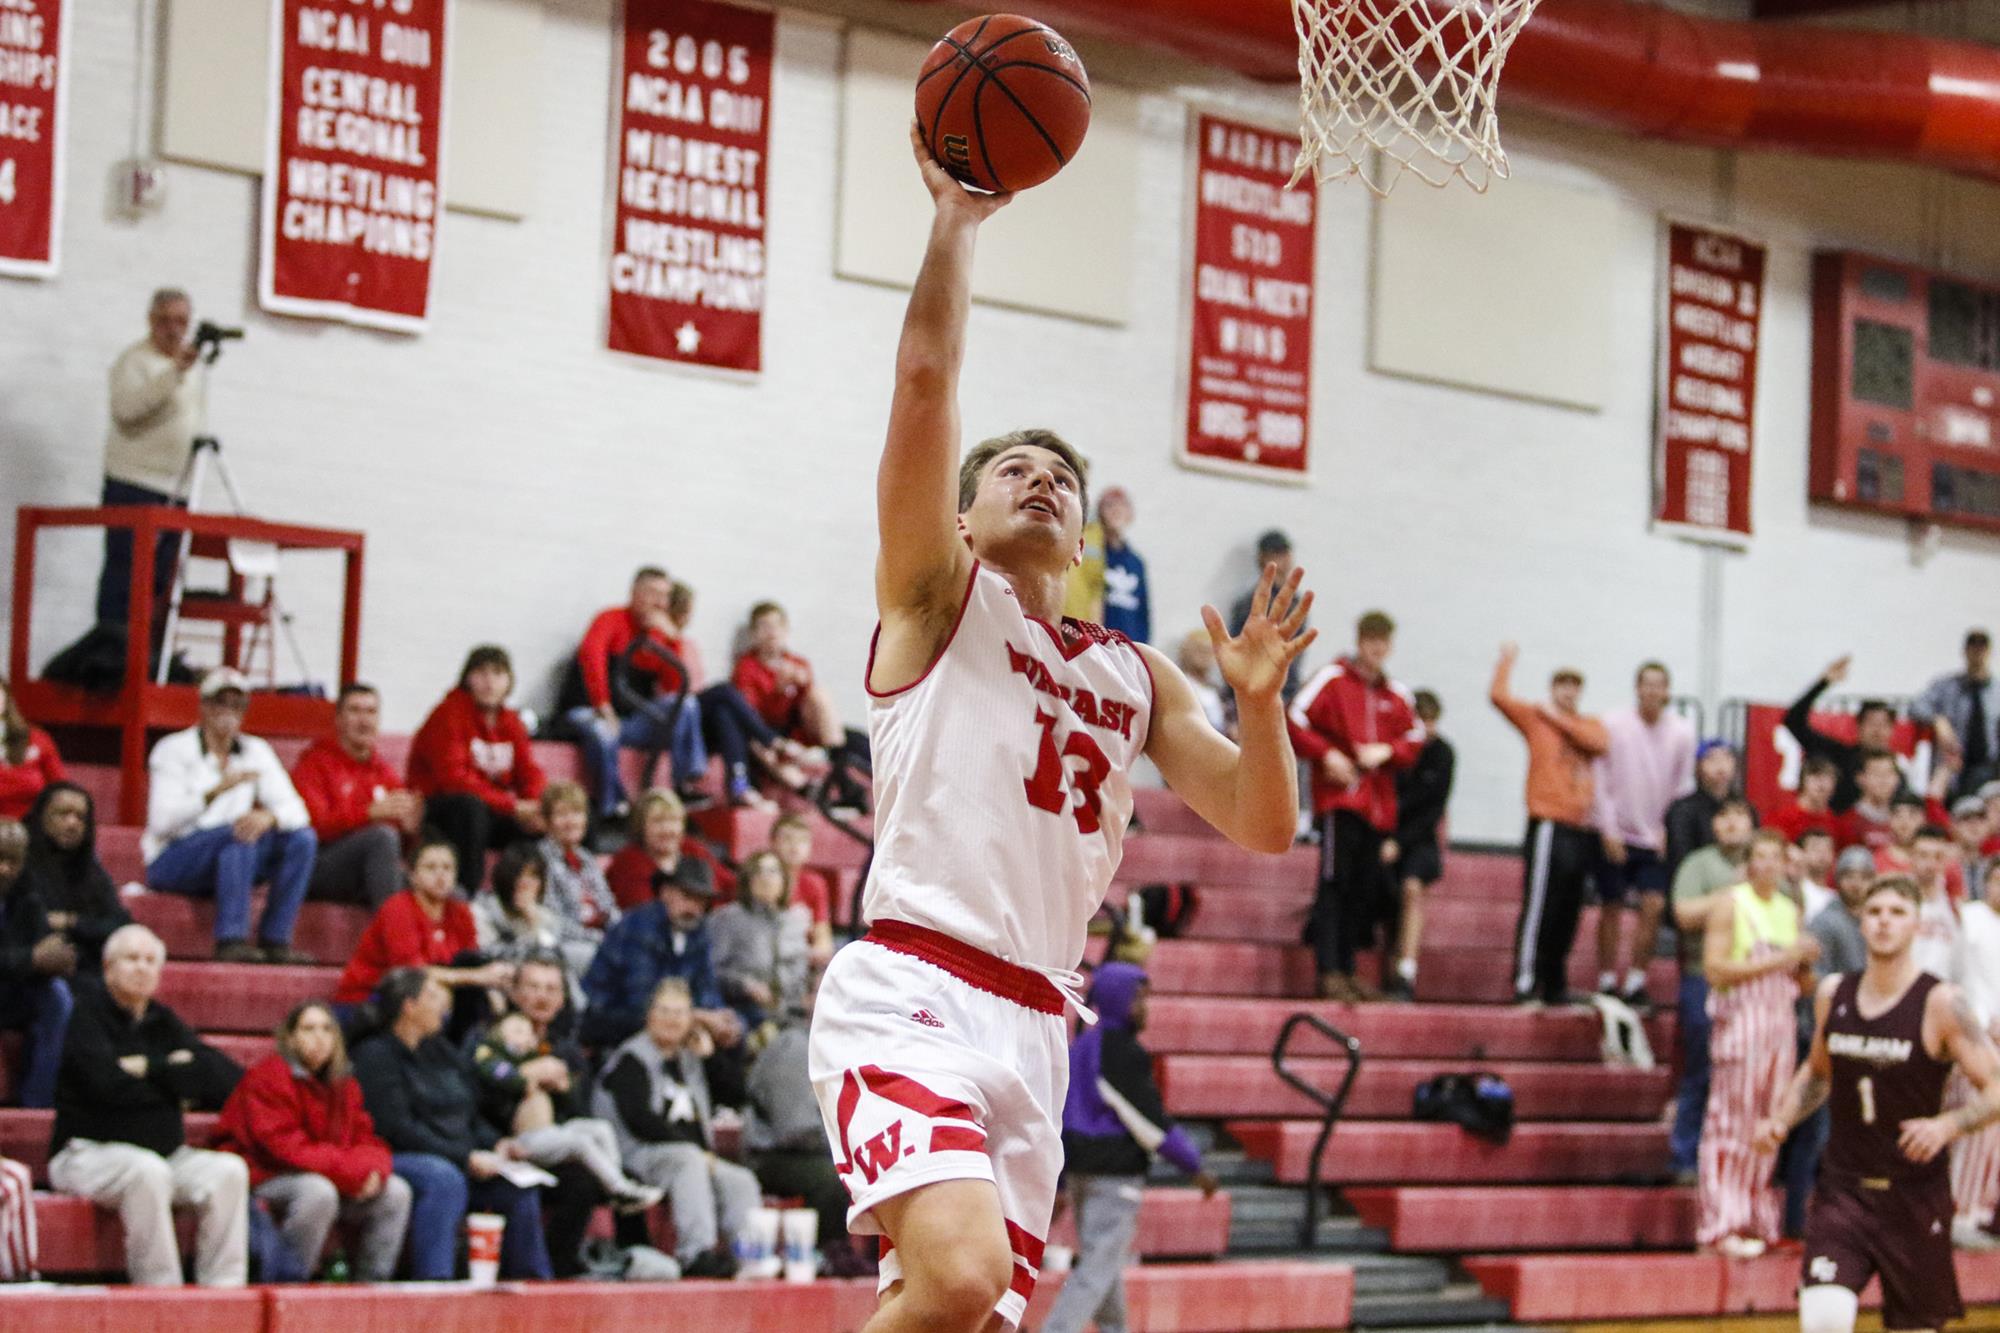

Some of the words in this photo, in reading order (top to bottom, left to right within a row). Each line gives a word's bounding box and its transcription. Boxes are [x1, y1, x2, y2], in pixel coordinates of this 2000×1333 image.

[647, 29, 749, 84] 2005
[302, 66, 422, 124] CENTRAL
[627, 72, 704, 122] NCAA
[298, 106, 426, 165] REGONAL
[625, 216, 763, 273] WRESTLING
[1024, 703, 1110, 833] 13
[1857, 1076, 1876, 1124] 1
